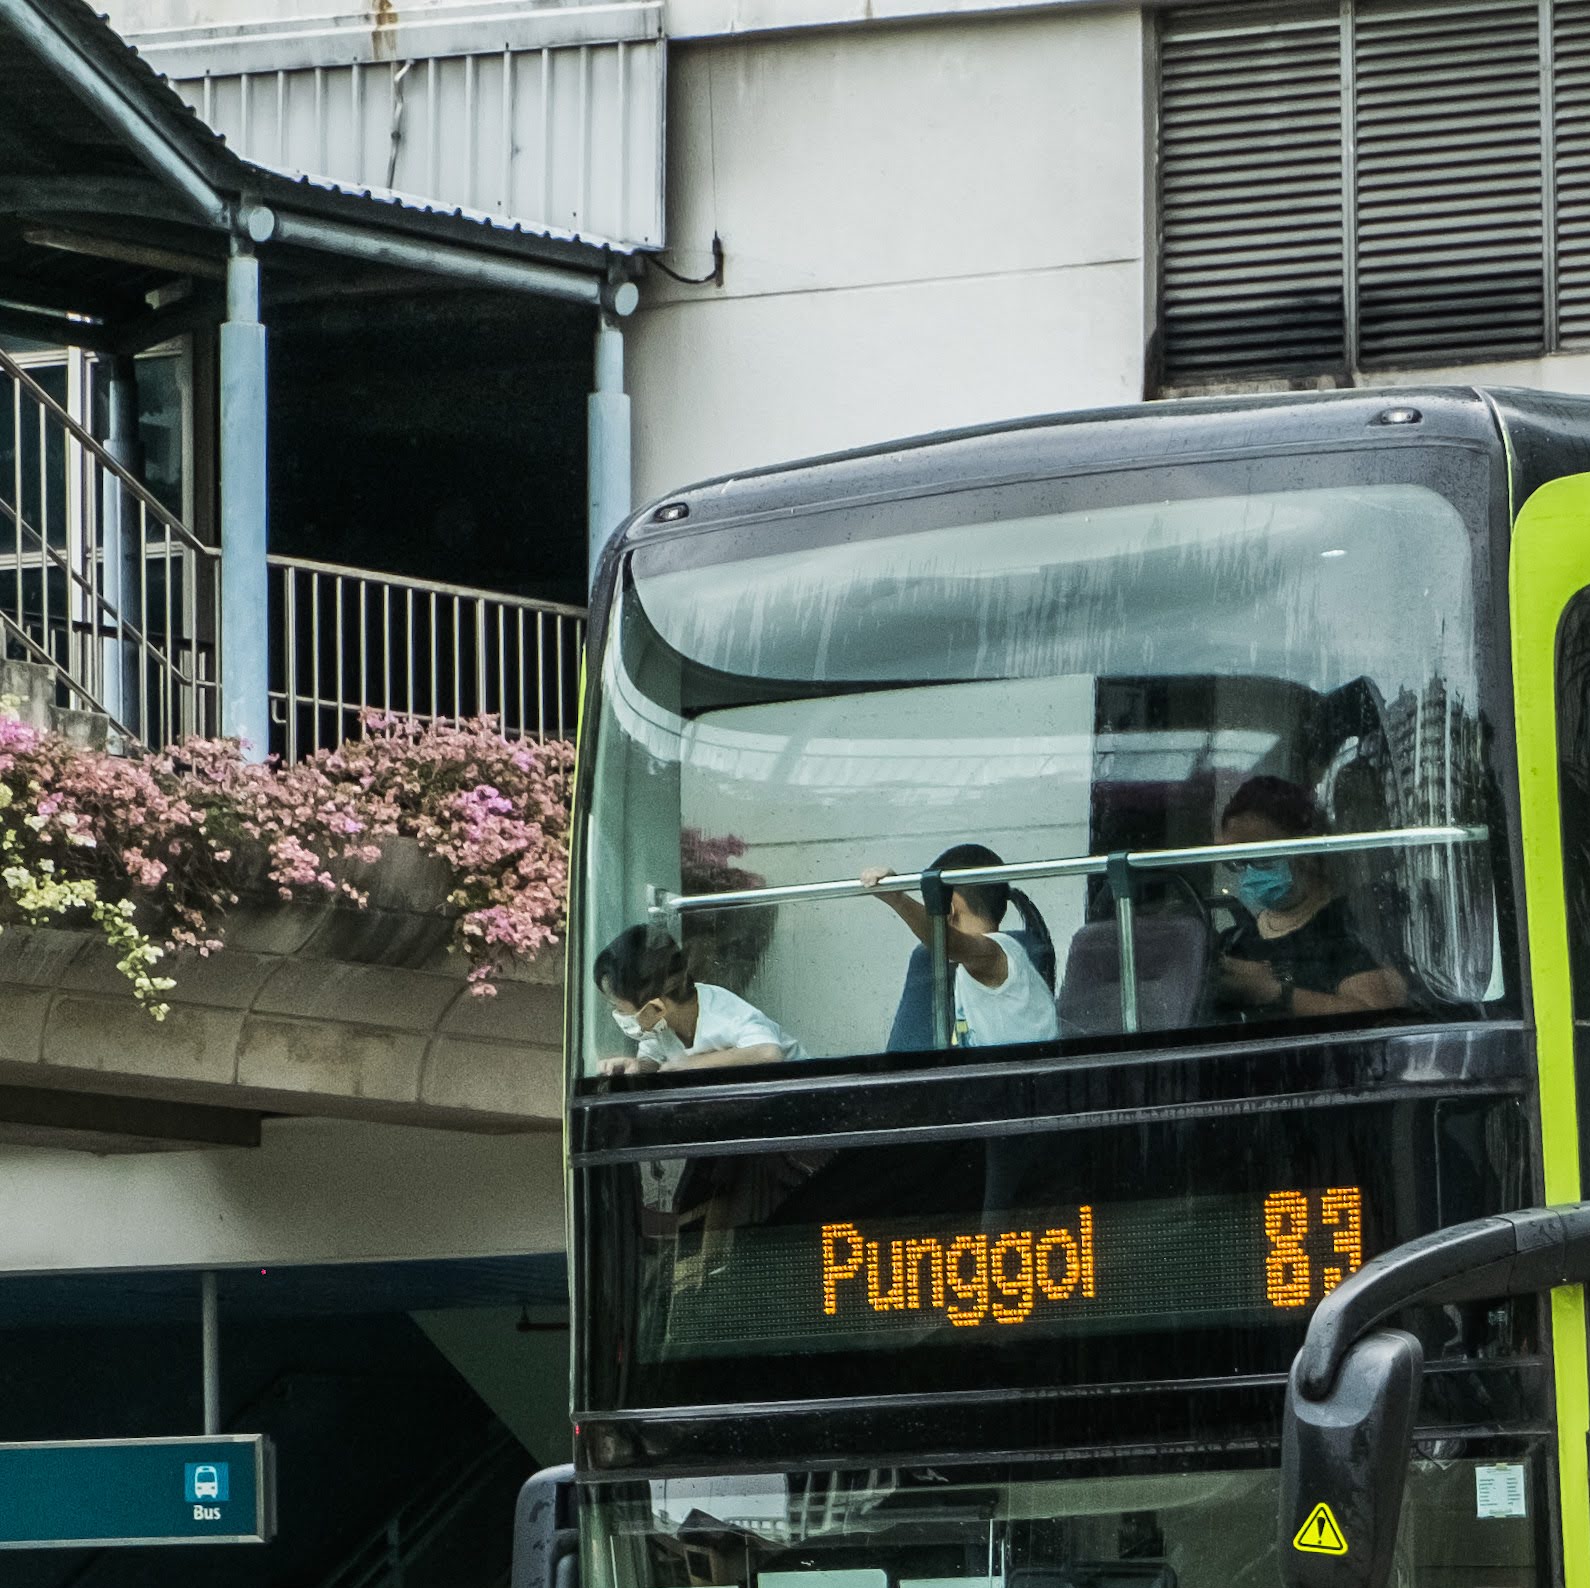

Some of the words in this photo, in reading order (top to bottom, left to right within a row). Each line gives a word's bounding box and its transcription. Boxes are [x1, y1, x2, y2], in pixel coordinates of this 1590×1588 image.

[821, 1205, 1096, 1327] Punggol
[1263, 1186, 1362, 1308] 83
[193, 1504, 222, 1520] Bus
